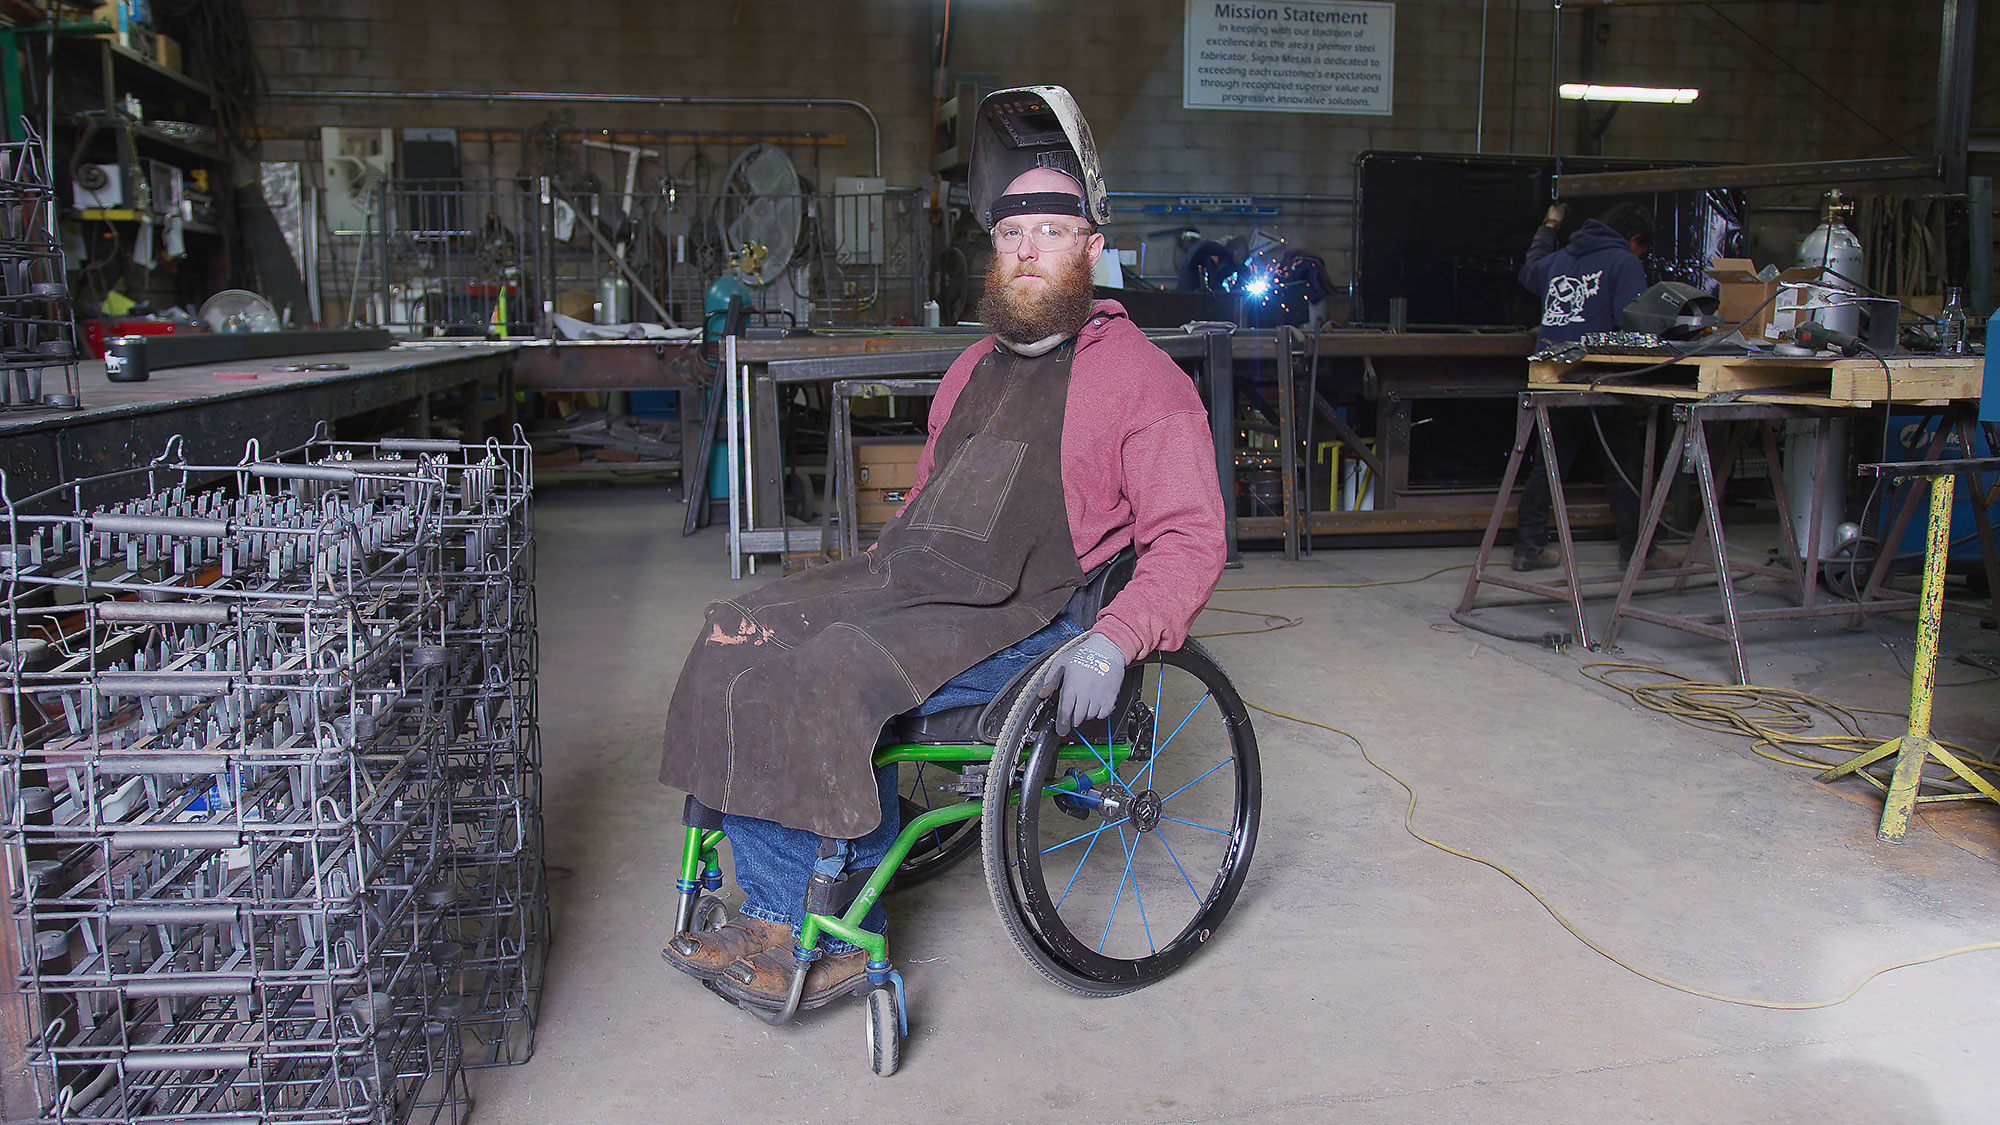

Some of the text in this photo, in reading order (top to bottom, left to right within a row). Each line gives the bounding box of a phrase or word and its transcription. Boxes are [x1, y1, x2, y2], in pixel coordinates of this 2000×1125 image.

[1215, 3, 1368, 24] Mission Statement
[1218, 23, 1364, 38] In keeping with our tradition of
[1206, 37, 1255, 47] excellence
[1257, 40, 1267, 48] as
[1270, 40, 1285, 48] the
[1316, 42, 1352, 52] premier
[1354, 43, 1376, 53] steel
[1251, 53, 1279, 64] Sigma
[1281, 54, 1311, 64] Metals
[1323, 56, 1368, 66] dedicated
[1370, 58, 1380, 67] to
[1198, 66, 1382, 81] exceeding each customer's expectations
[1200, 79, 1379, 94] through recognized superior value and
[1222, 93, 1371, 107] progressive innovative solutions.
